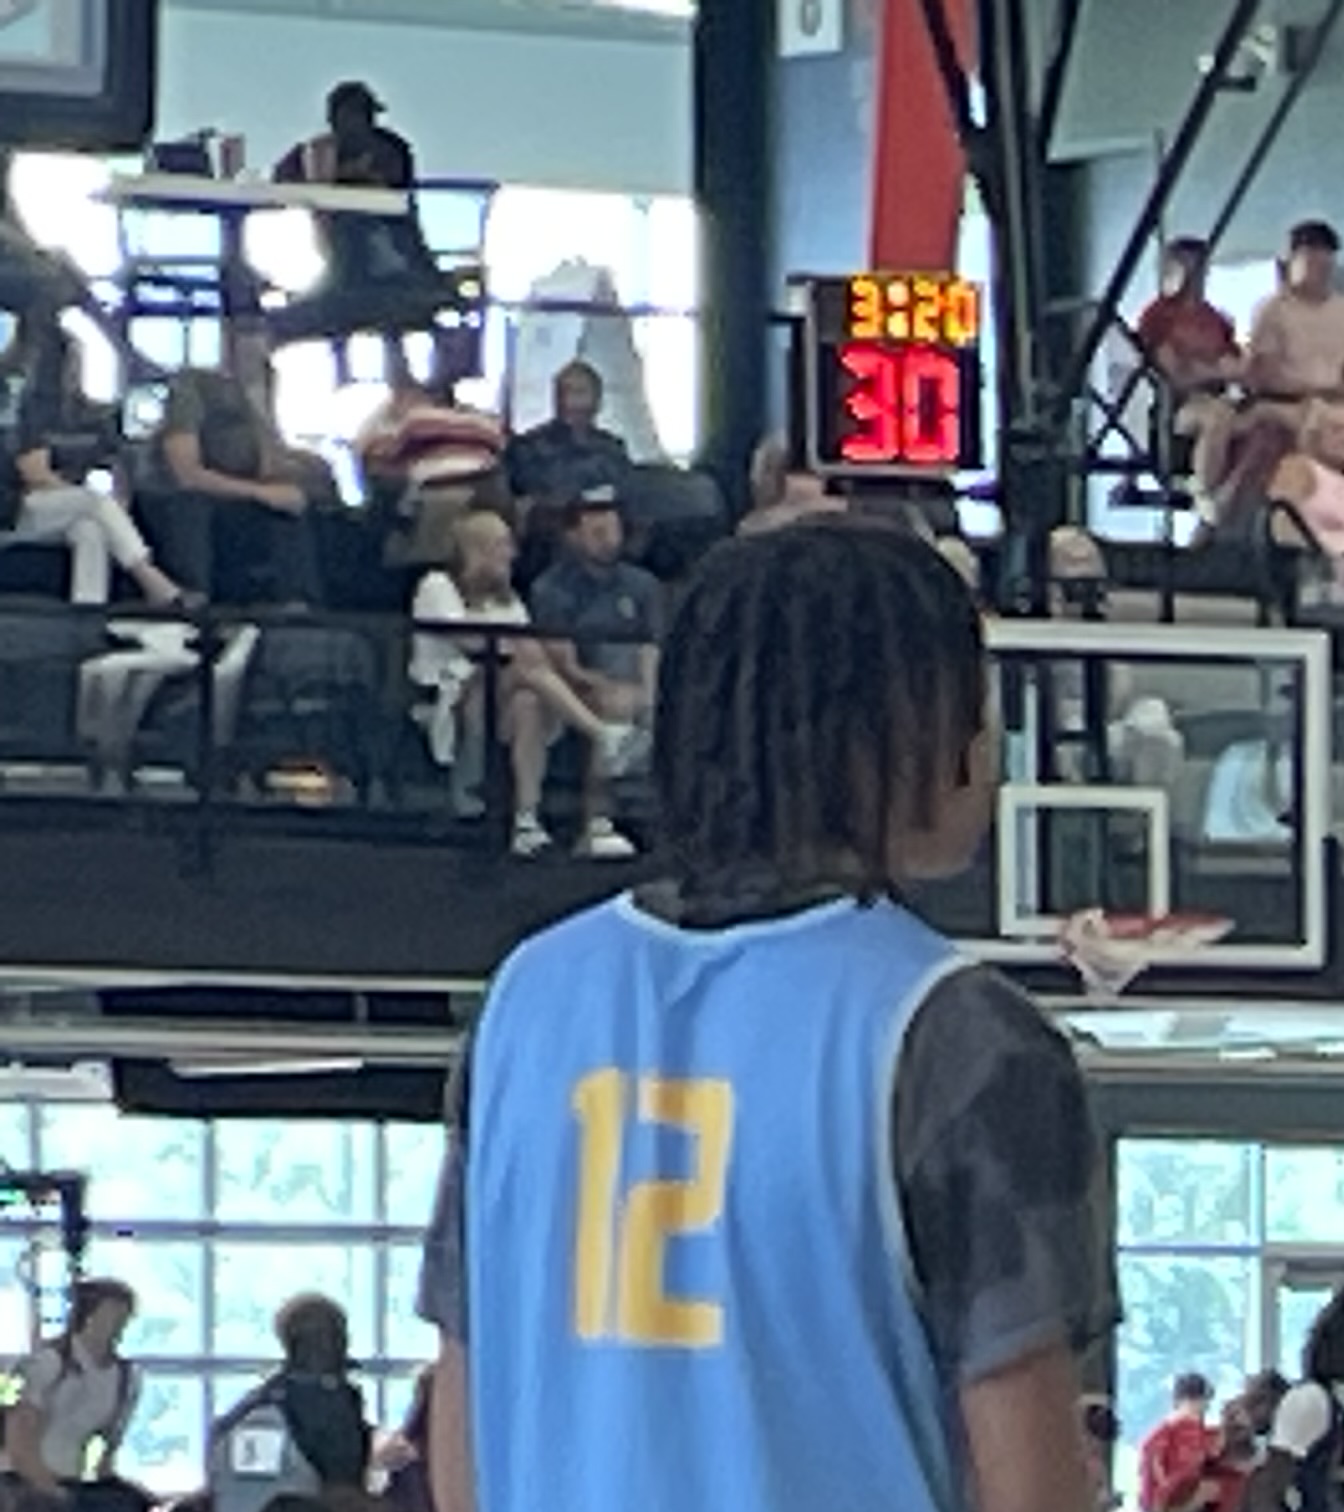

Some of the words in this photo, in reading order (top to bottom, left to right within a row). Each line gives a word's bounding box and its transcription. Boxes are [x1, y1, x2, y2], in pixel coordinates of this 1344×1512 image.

[848, 275, 979, 344] 3:20
[839, 345, 962, 463] 30
[570, 1065, 736, 1350] 12
